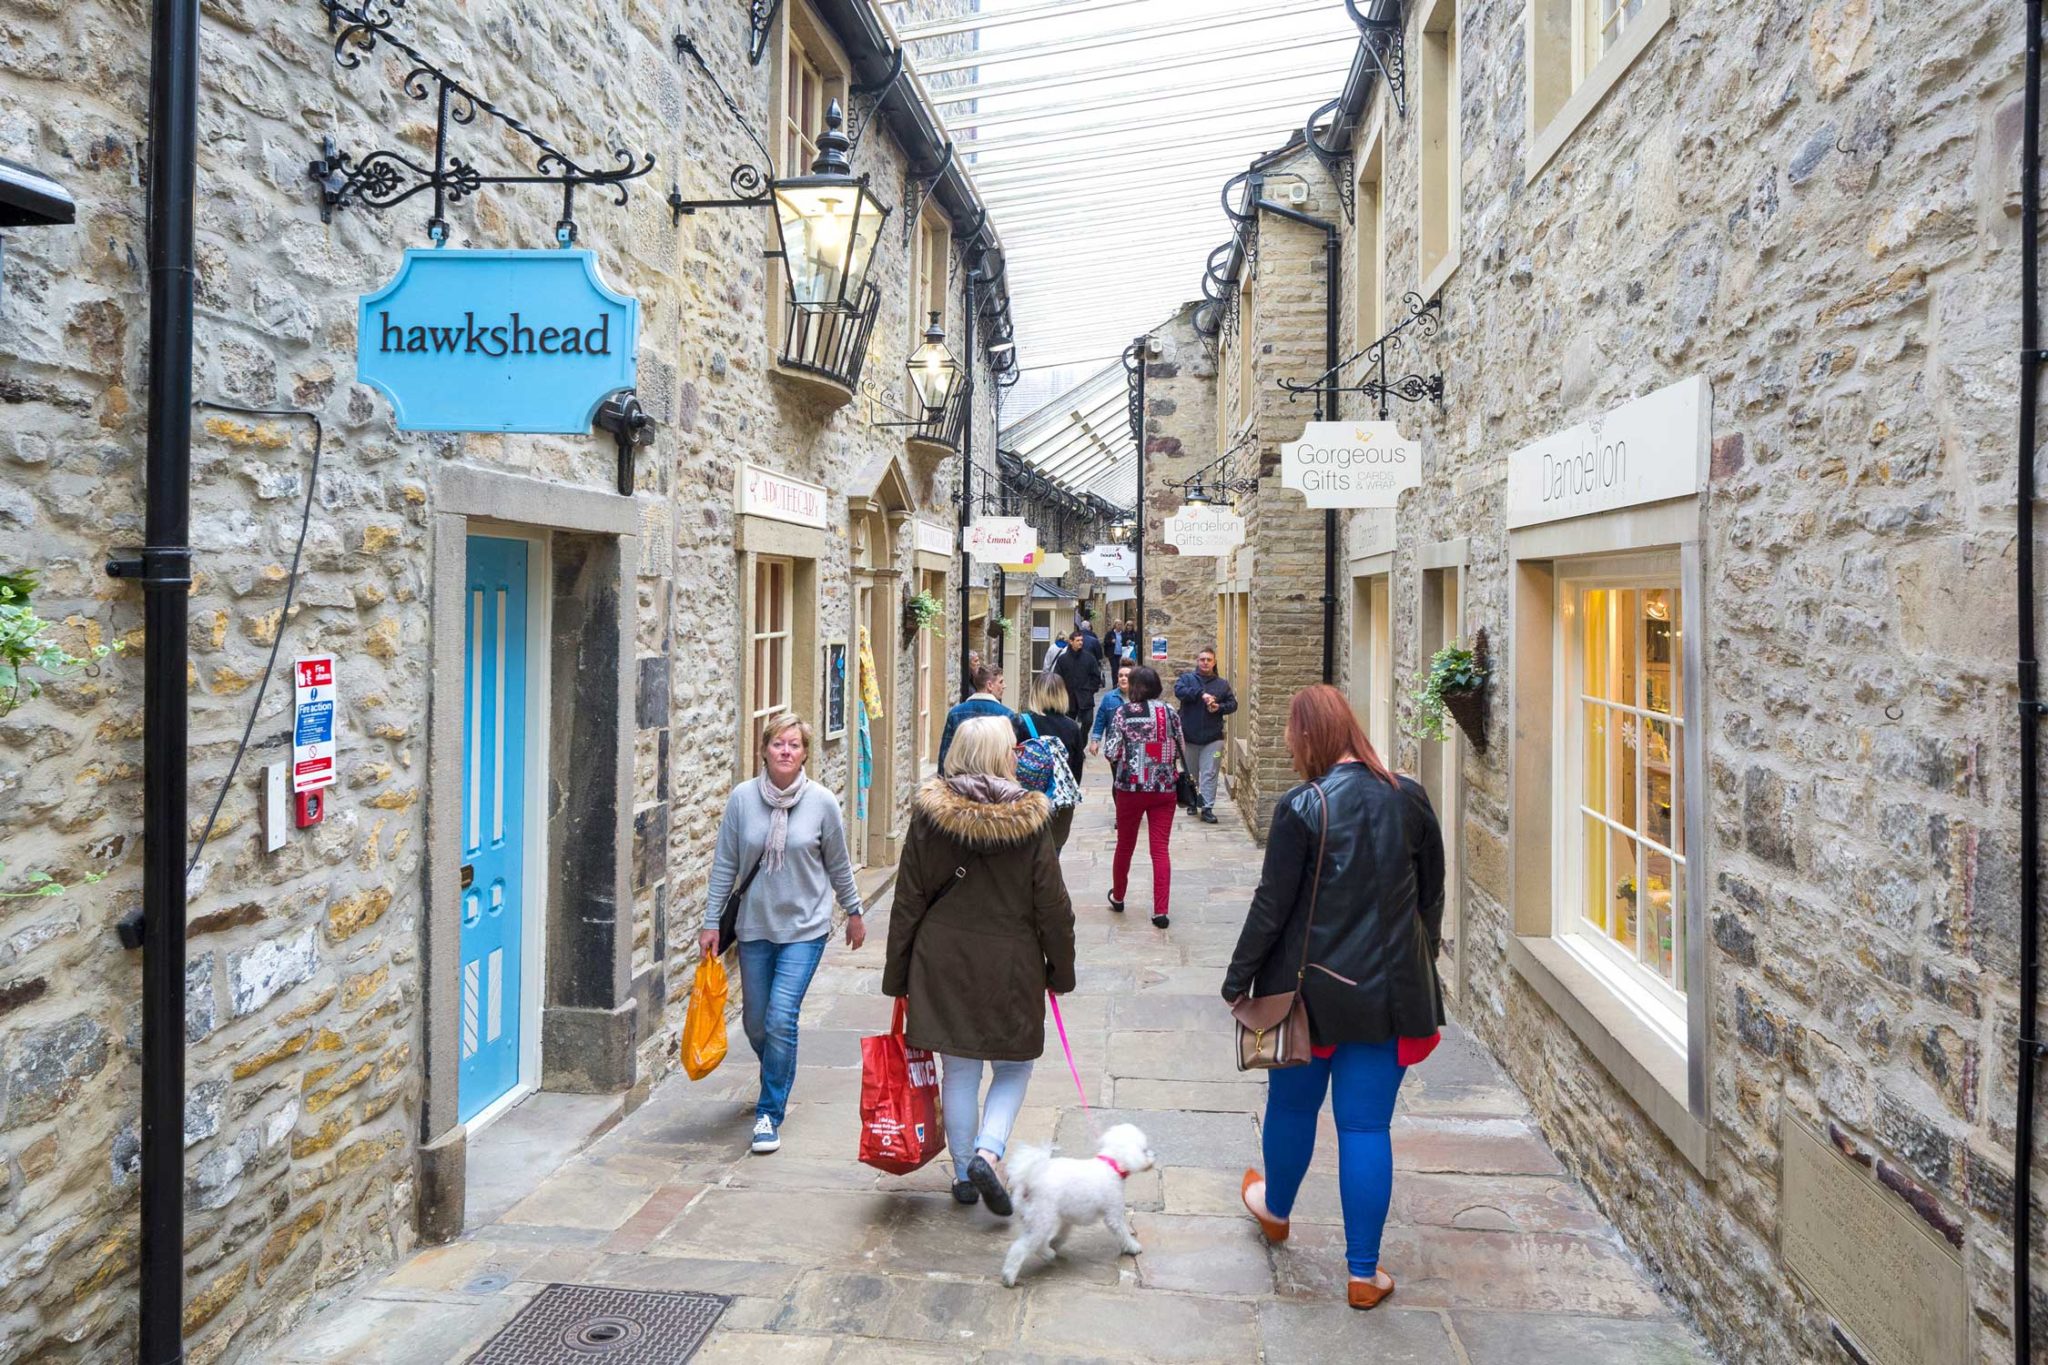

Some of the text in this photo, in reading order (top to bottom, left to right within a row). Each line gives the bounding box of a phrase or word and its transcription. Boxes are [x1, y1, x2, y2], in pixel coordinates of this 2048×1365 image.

[380, 311, 611, 357] hawkshead
[1297, 443, 1407, 469] Gorgeous
[1542, 435, 1627, 502] Dandelion
[1302, 469, 1350, 491] Gifts
[1357, 471, 1395, 480] CARDS
[1355, 481, 1396, 490] & WRAP
[1174, 516, 1239, 532] Dandelion
[987, 533, 1017, 545] Emma's
[1175, 533, 1203, 546] Gifts
[315, 664, 325, 673] Fire
[315, 672, 331, 681] alarm
[299, 702, 332, 714] Fire action
